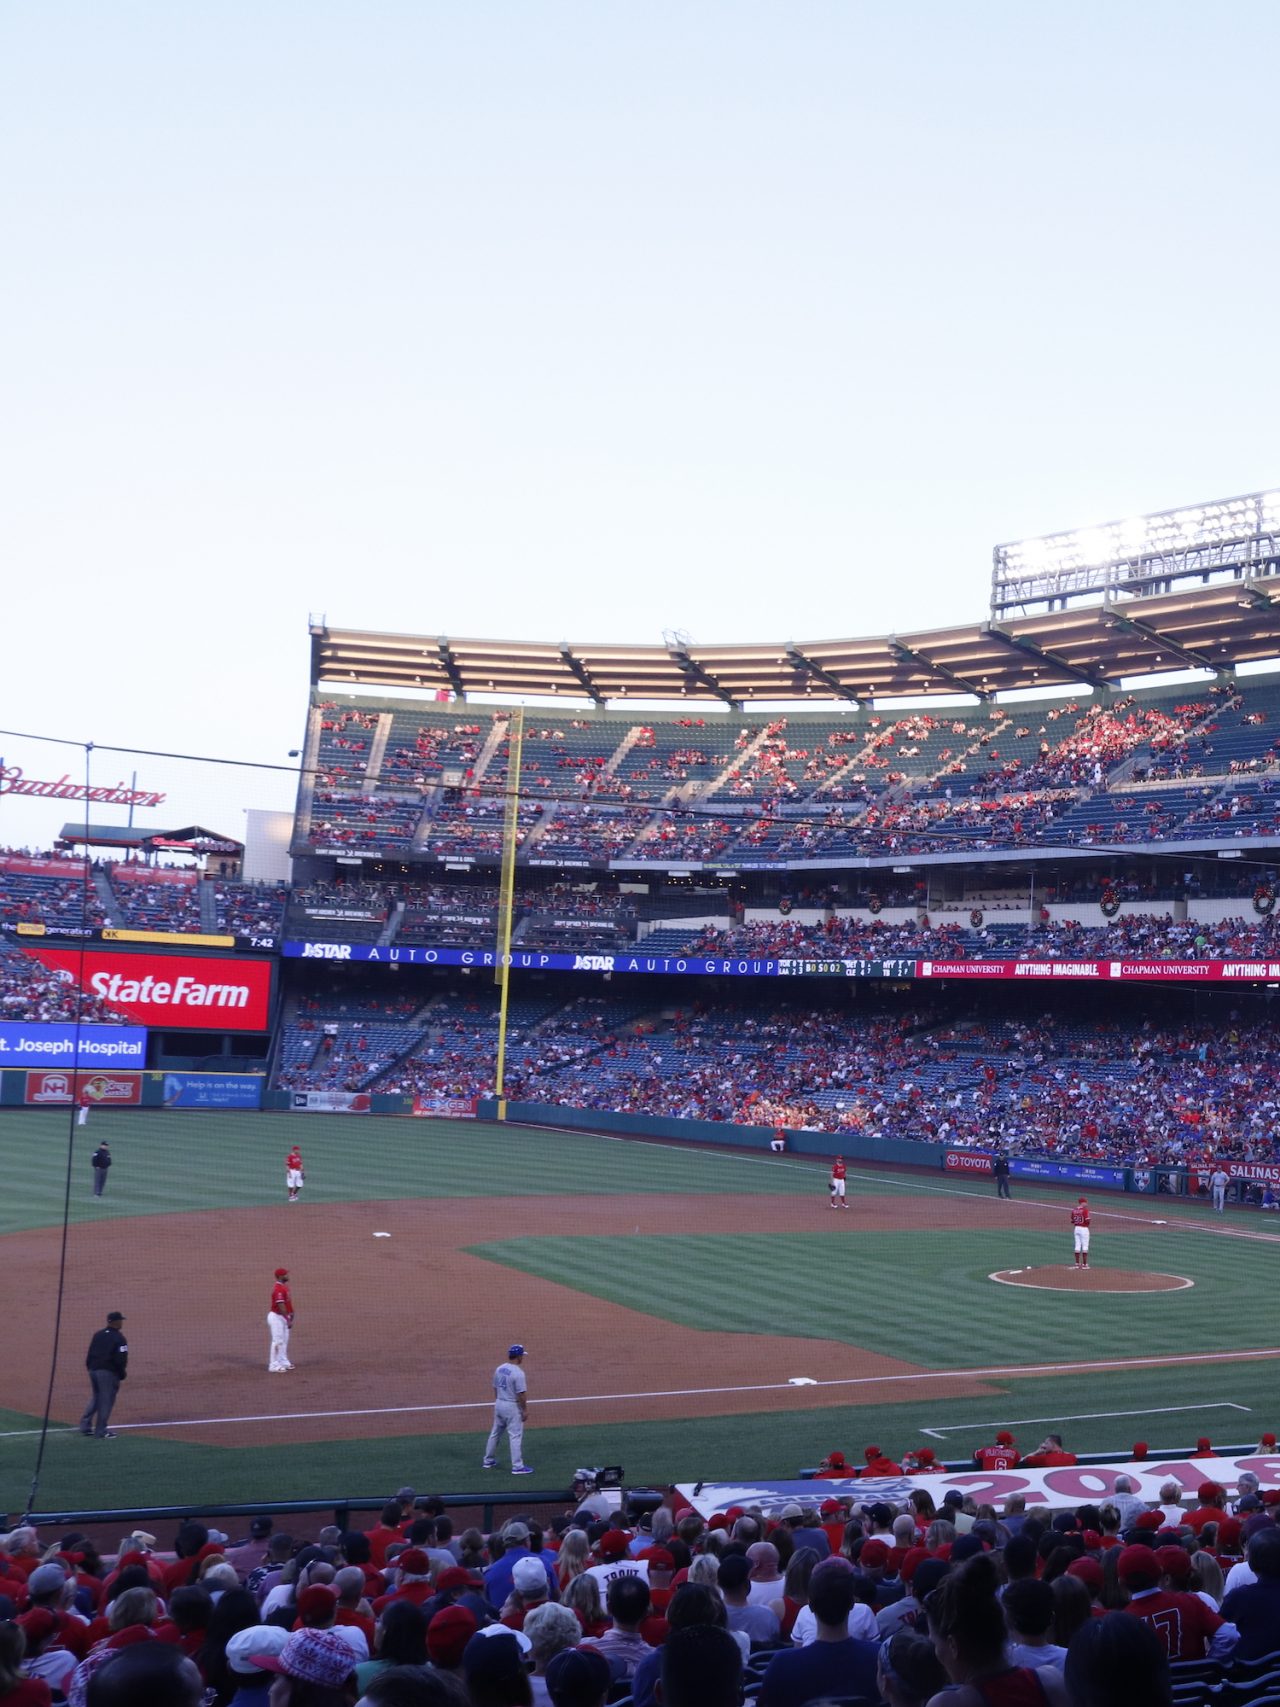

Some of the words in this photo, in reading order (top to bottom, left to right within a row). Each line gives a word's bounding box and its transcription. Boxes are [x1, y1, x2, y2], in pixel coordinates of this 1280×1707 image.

[0, 766, 167, 807] Budweiser
[251, 937, 274, 948] 7:42
[368, 947, 438, 962] AUTO
[629, 958, 687, 972] AUTO
[705, 961, 774, 974] GROUP
[933, 965, 965, 974] CHAPMAN
[966, 965, 1005, 975] UNIVERSITY
[1014, 963, 1051, 976] ANYTHING
[1052, 963, 1099, 976] IMAGINABLE.
[1122, 965, 1162, 975] CHAPMAN
[1163, 965, 1210, 975] UNIVERSITY
[1222, 963, 1266, 977] ANYTHING
[14, 1038, 74, 1056] Joseph
[78, 1039, 142, 1057] Hospital
[186, 1081, 206, 1090] Help
[226, 1081, 239, 1090] the
[960, 1156, 992, 1169] TOYOTA
